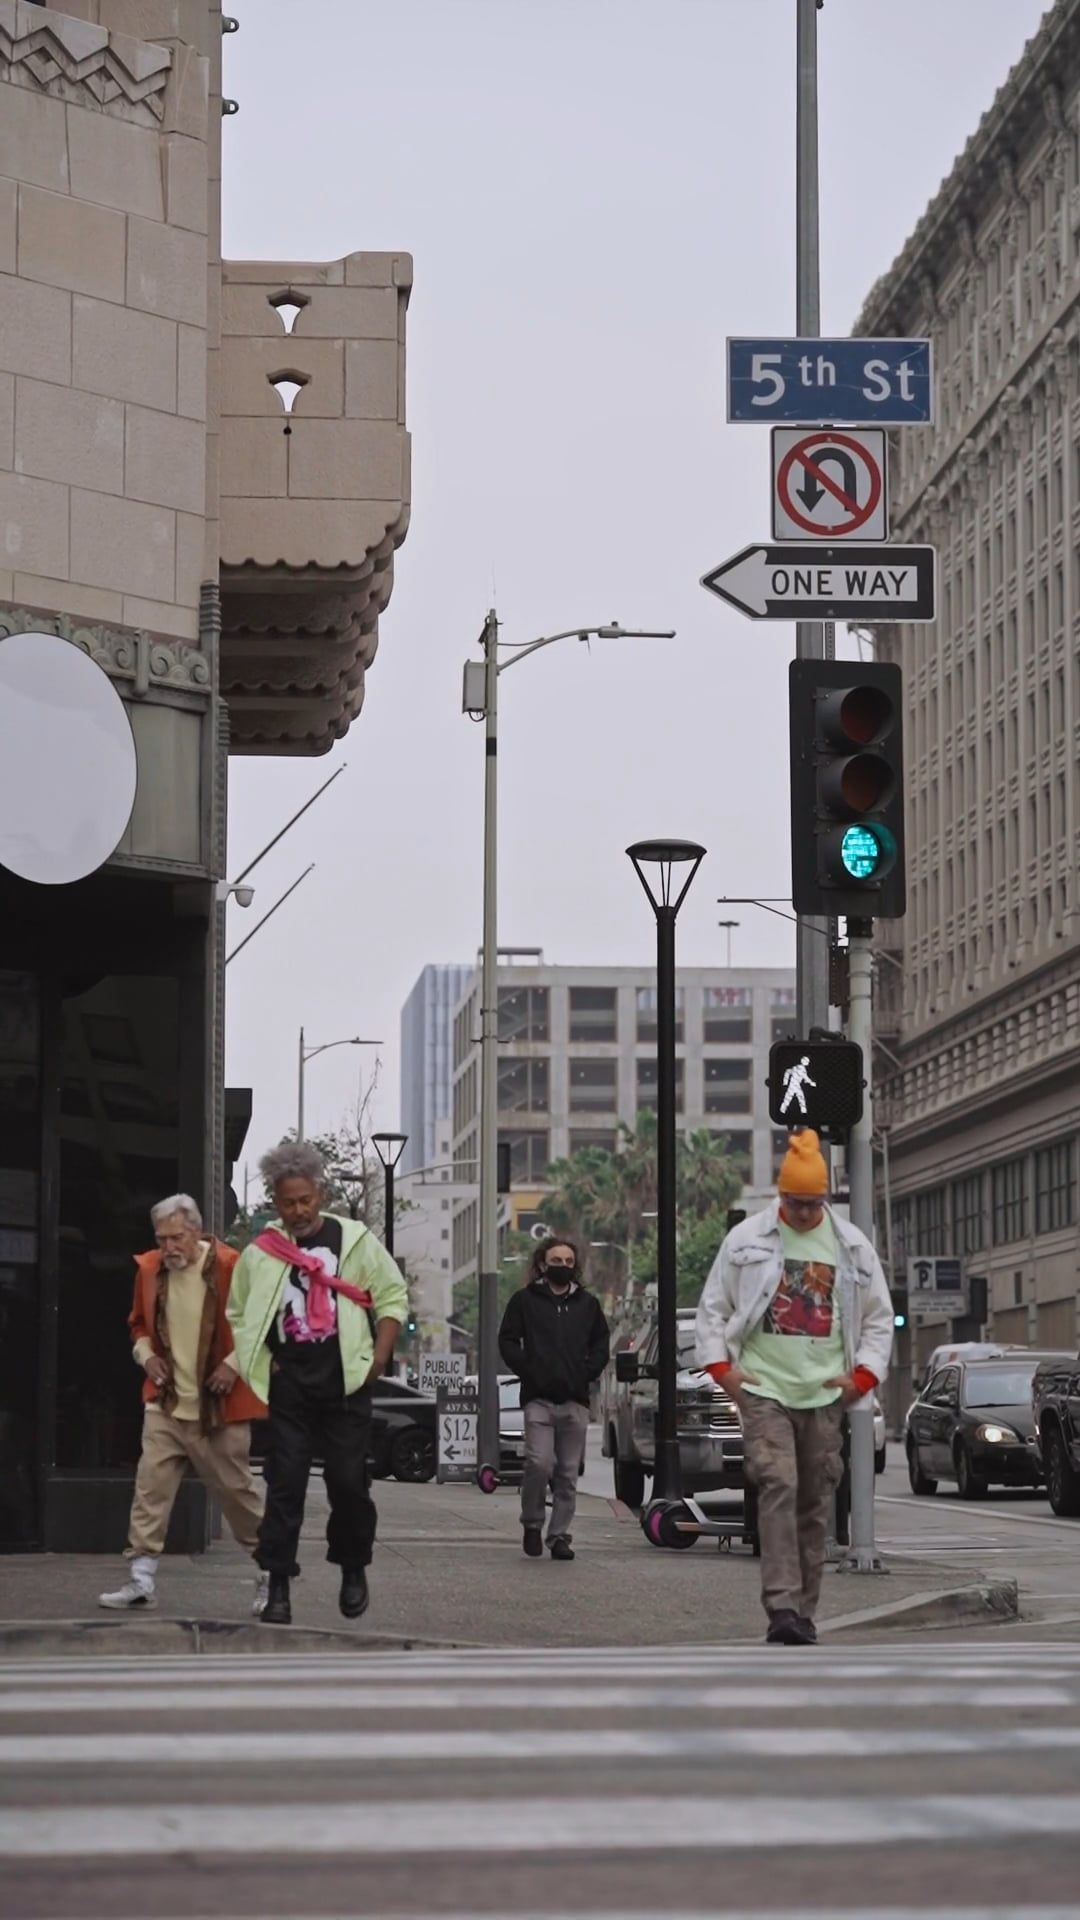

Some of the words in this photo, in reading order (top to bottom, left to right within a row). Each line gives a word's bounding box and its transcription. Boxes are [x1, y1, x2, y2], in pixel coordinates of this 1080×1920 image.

[751, 353, 836, 406] 5th
[862, 359, 915, 402] St
[771, 569, 833, 596] ONE
[845, 570, 908, 596] WAY
[425, 1360, 460, 1374] PUBLIC
[421, 1375, 464, 1390] PARKING
